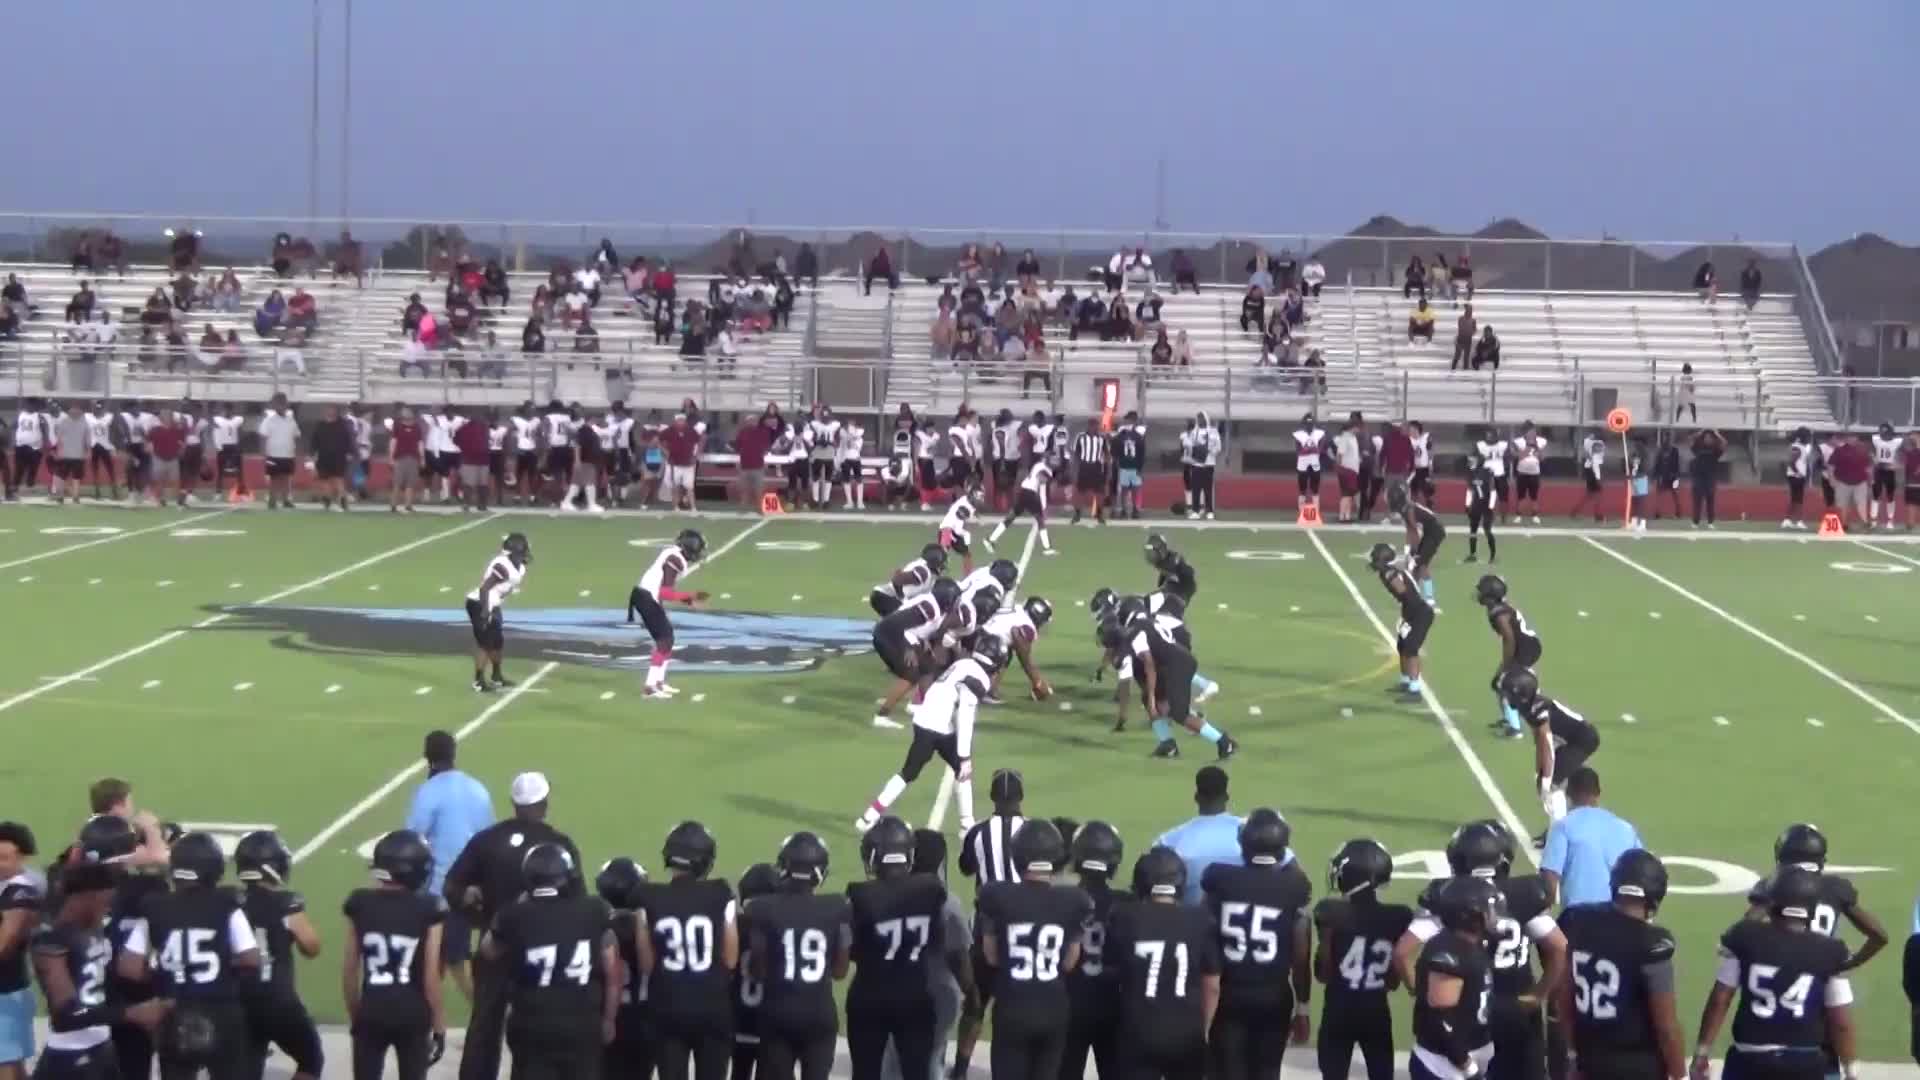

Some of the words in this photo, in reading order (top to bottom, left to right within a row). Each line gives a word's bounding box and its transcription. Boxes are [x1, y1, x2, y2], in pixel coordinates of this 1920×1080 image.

[765, 497, 779, 512] 50
[1825, 517, 1839, 532] 30
[159, 928, 221, 984] 45
[362, 931, 420, 986] 27
[655, 914, 714, 972] 30
[781, 927, 828, 983] 19
[874, 914, 931, 962] 77
[1007, 922, 1065, 982] 58
[1220, 901, 1282, 964] 55
[526, 939, 592, 987] 74
[1134, 940, 1189, 998] 71
[1339, 935, 1393, 990] 42
[1571, 950, 1621, 1020] 52
[1748, 962, 1815, 1019] 54
